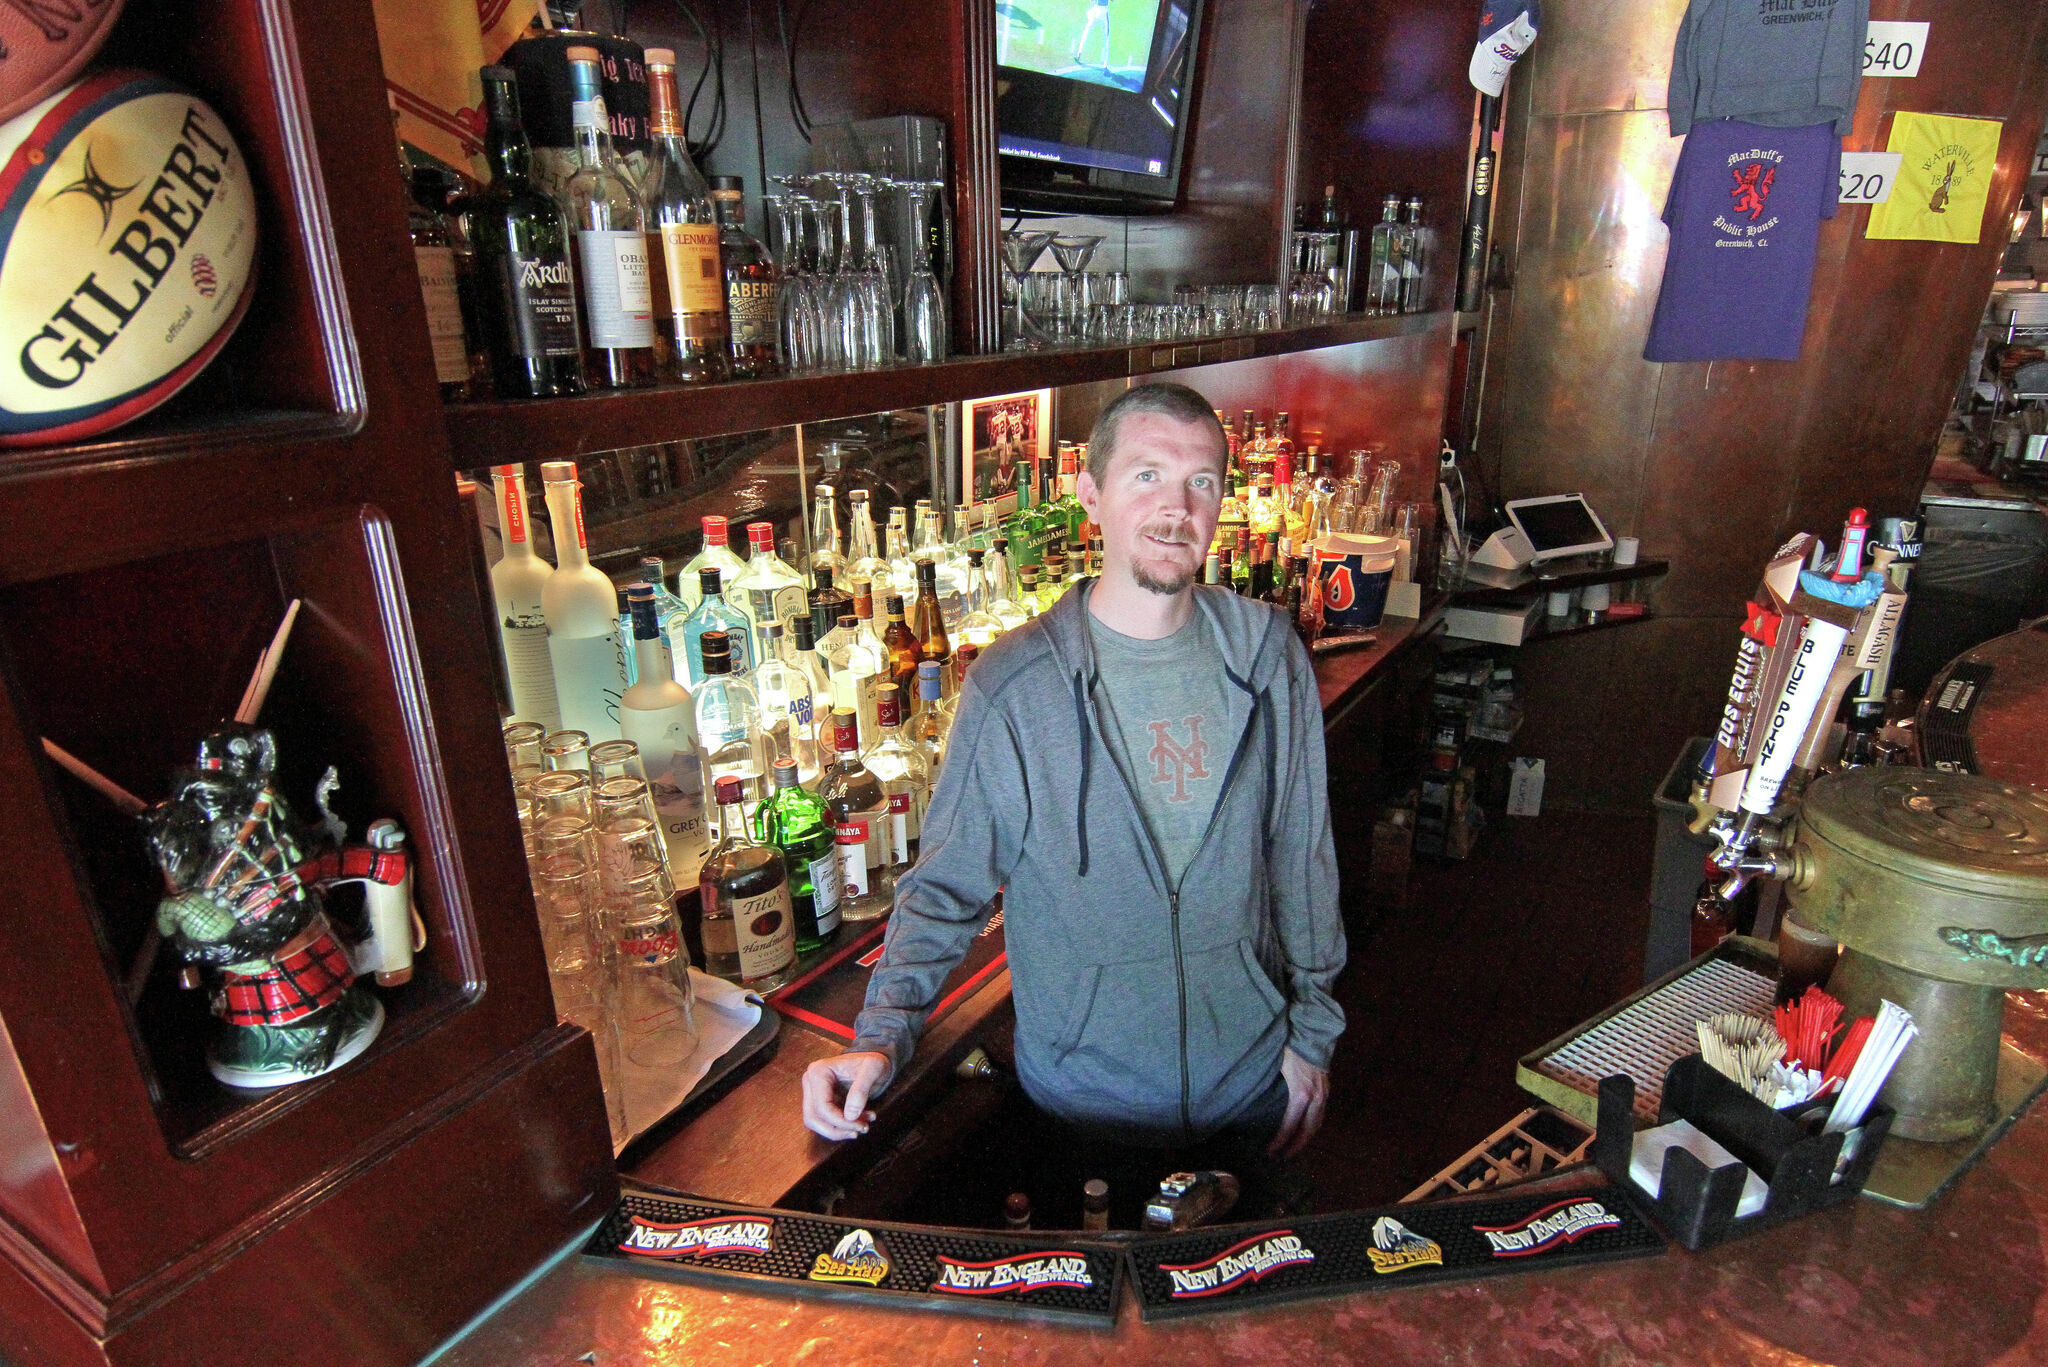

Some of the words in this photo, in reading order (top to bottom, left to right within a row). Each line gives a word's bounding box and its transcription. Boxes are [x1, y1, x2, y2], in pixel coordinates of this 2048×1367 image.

[1762, 11, 1824, 25] GREENWICH,
[600, 54, 620, 84] ig
[624, 58, 647, 84] Tex
[1728, 149, 1784, 167] MacDuff's
[1922, 144, 1975, 177] WATERVILLE
[1713, 215, 1743, 236] Public
[1746, 217, 1779, 237] House
[20, 106, 229, 389] GILBERT
[515, 257, 570, 289] Ardb
[729, 282, 778, 298] ABERF
[165, 304, 193, 344] official
[555, 315, 571, 323] TEN
[728, 632, 745, 643] MBAY
[822, 643, 844, 651] HEN
[1866, 599, 1902, 665] ALLAGASH
[1728, 637, 1758, 703] EQUIS
[1785, 639, 1815, 696] BLUE
[789, 695, 812, 715] ABS
[1718, 703, 1740, 748] DOS
[1761, 701, 1790, 767] POINT
[1147, 714, 1210, 803] NY
[669, 818, 701, 835] GREY
[624, 1225, 678, 1249] NEW
[672, 1223, 770, 1249] ENGLAND
[1485, 1231, 1534, 1252] NEW
[1527, 1203, 1606, 1244] ENGLAND
[940, 1264, 991, 1288] NEW
[990, 1258, 1087, 1287] ENGLAND
[1170, 1269, 1218, 1292] NEW
[1217, 1236, 1302, 1282] ENGLAND
